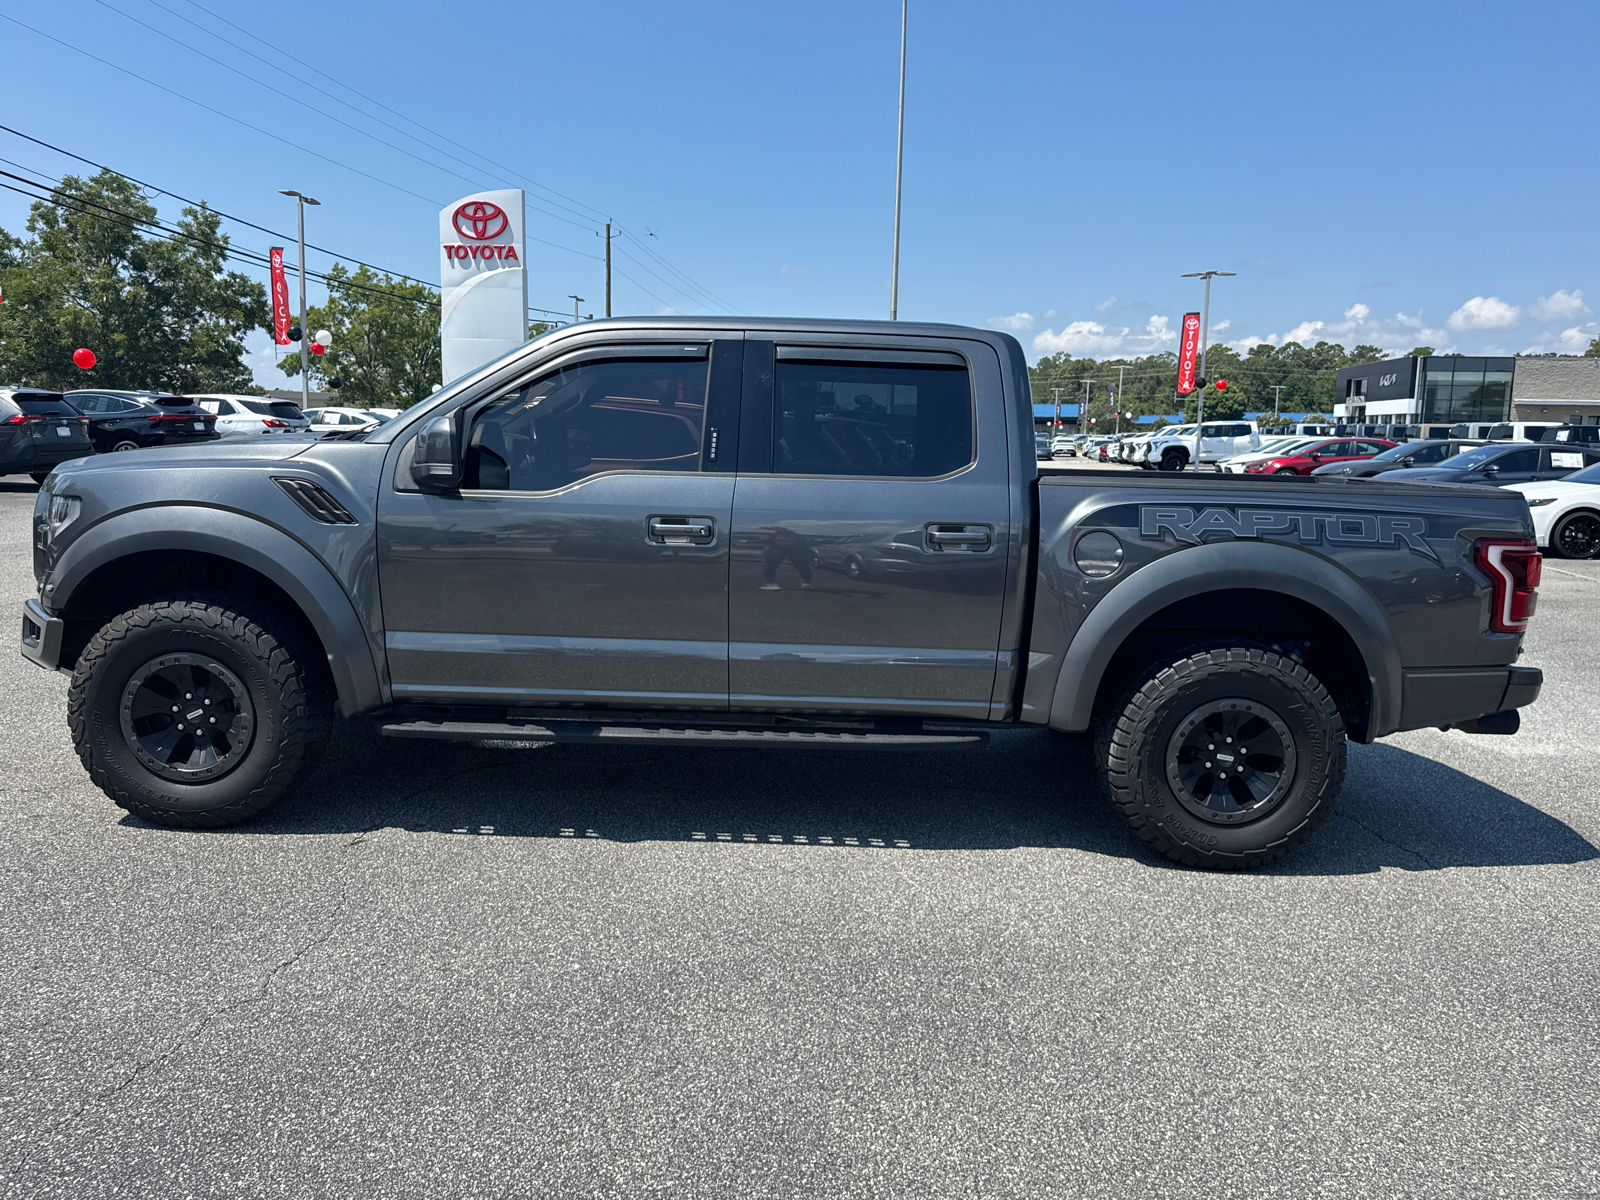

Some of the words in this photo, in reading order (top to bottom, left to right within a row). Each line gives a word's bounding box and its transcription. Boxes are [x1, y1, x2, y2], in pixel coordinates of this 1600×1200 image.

[443, 244, 519, 260] TOYOTA
[1182, 330, 1195, 390] TOYOTA
[1139, 505, 1444, 569] RAPTOR
